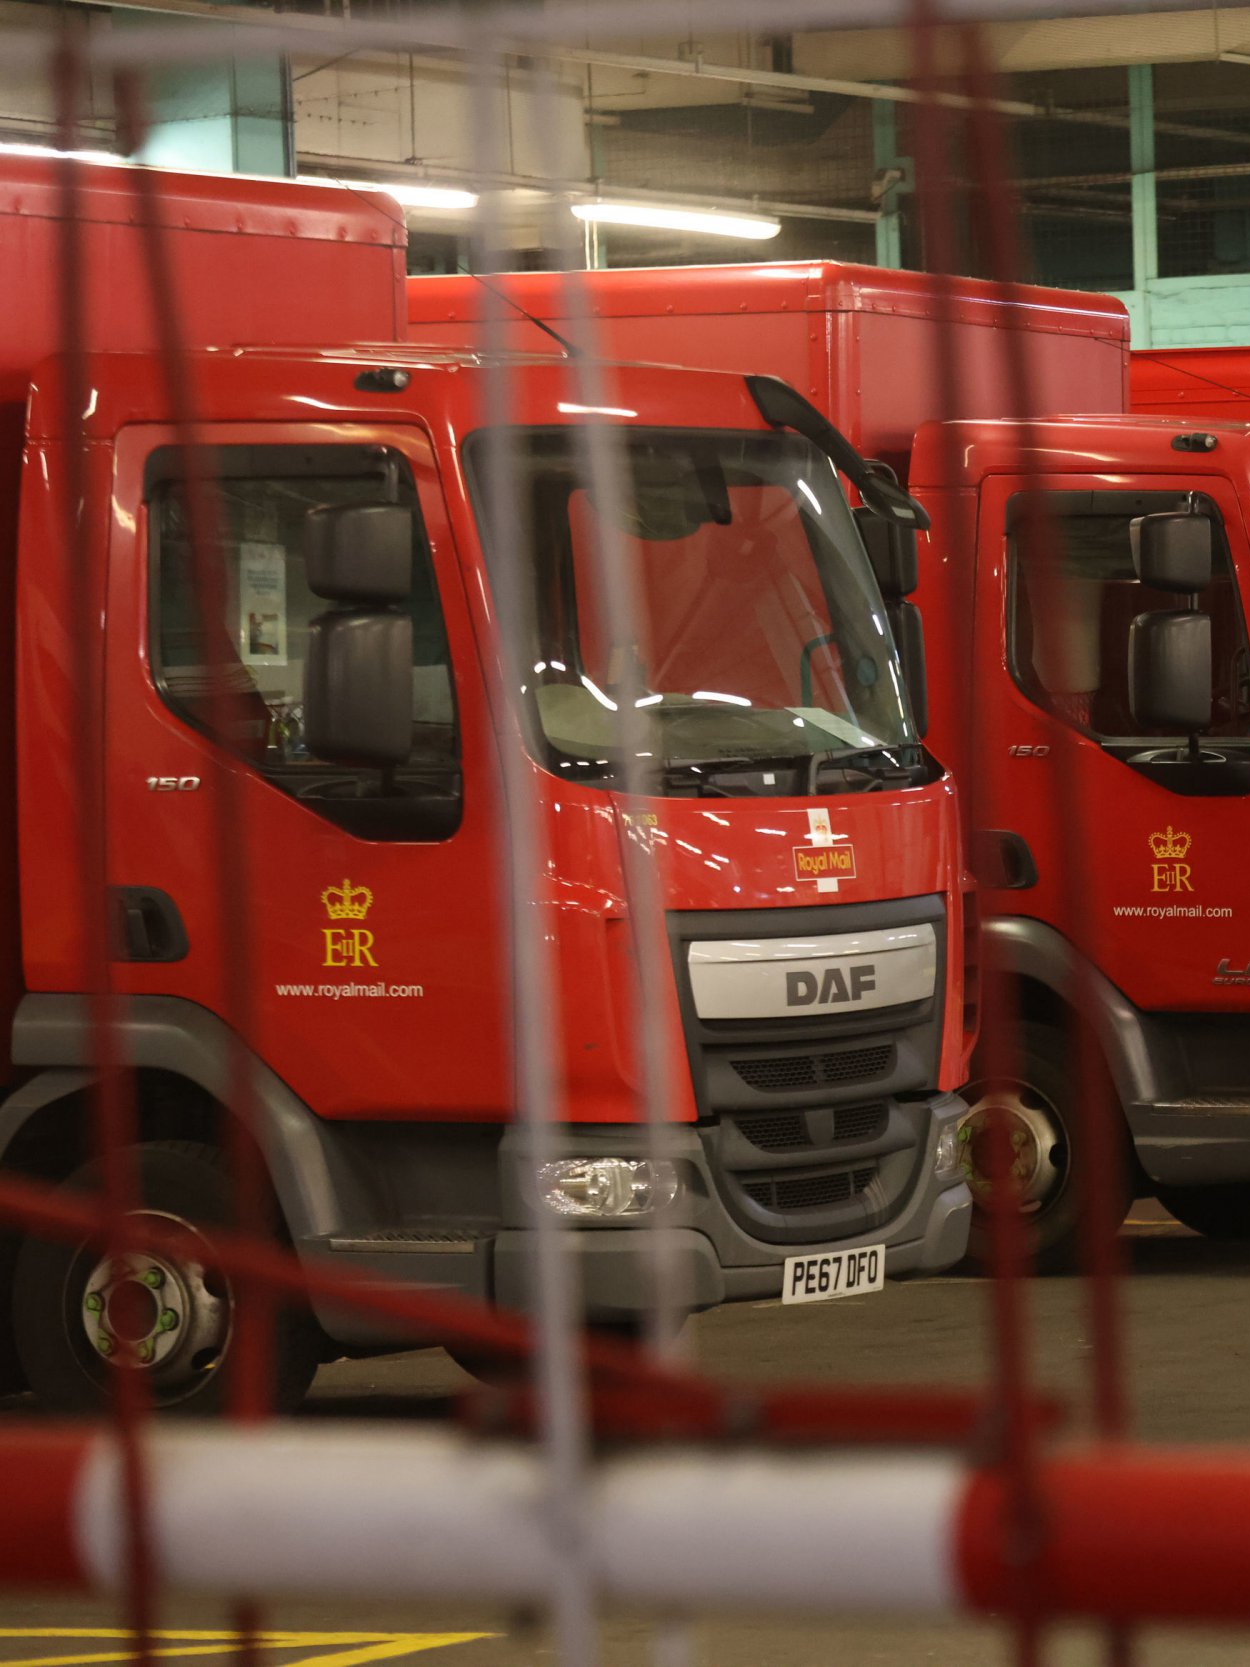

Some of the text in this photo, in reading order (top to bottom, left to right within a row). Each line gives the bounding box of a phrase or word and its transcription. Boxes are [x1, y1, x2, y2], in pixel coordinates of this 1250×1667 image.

[1007, 745, 1050, 757] 150
[145, 775, 201, 791] 150
[797, 850, 851, 875] Royal Mail
[1113, 905, 1233, 920] www.royalmail.com
[275, 981, 424, 1001] www.royalmail.com
[785, 964, 876, 1007] DAF
[792, 1256, 843, 1296] PE67
